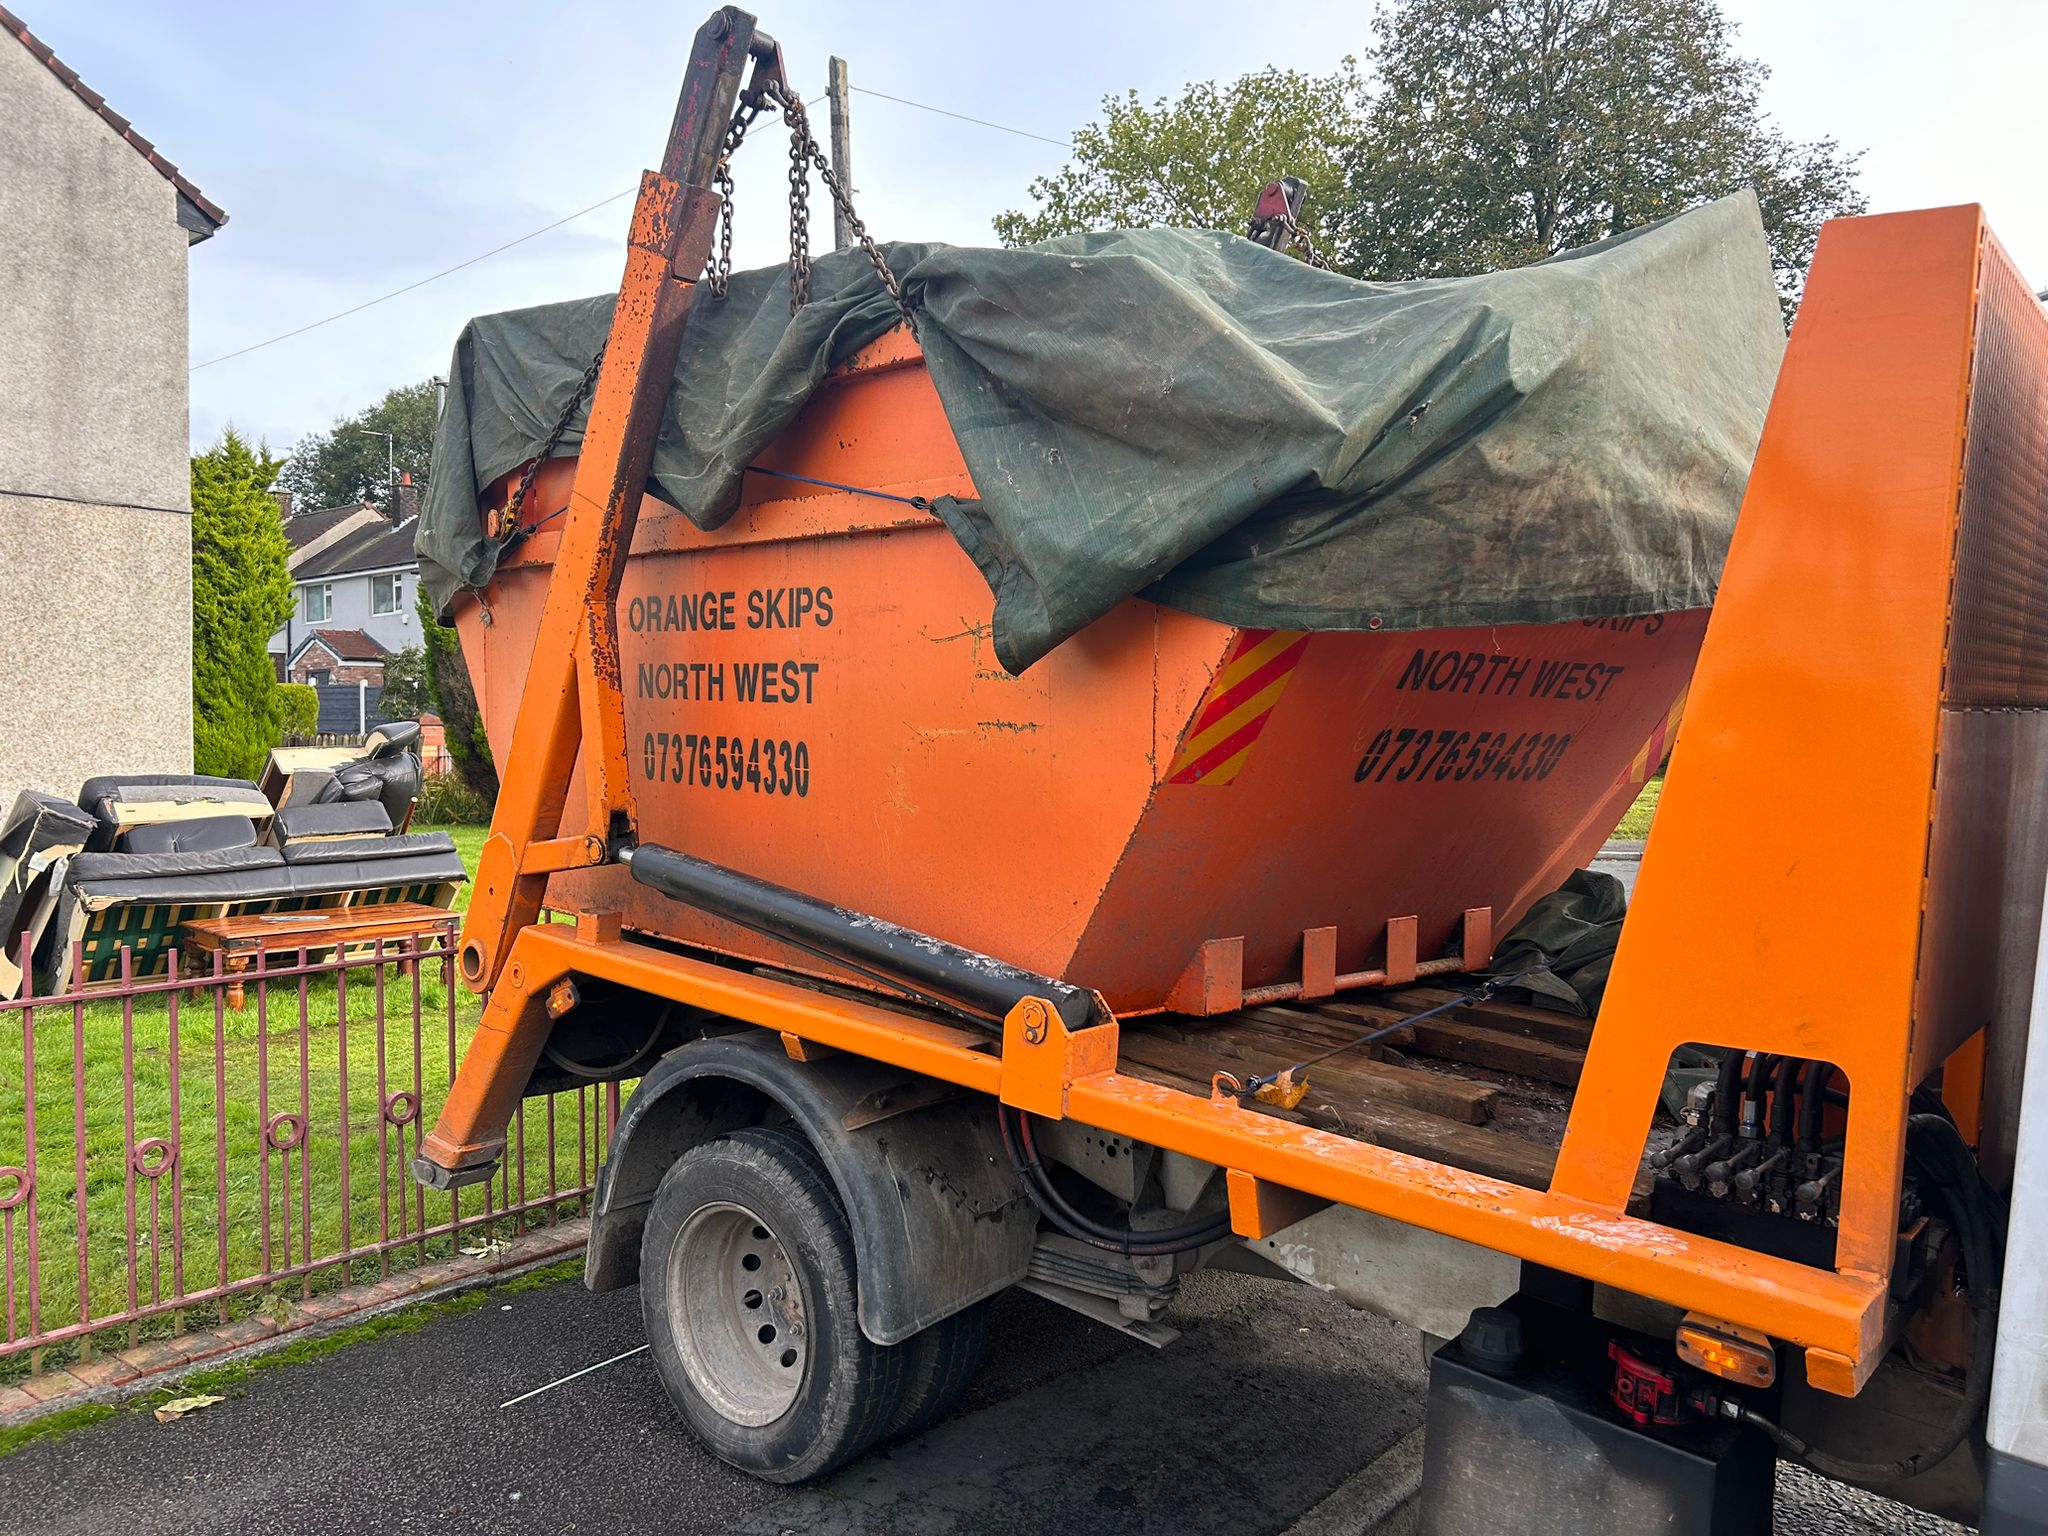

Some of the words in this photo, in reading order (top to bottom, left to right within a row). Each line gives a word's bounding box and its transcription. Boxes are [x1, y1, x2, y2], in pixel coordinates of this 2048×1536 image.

[629, 591, 735, 632] ORANGE
[747, 586, 833, 629] SKIPS
[638, 663, 724, 701] NORTH
[734, 660, 819, 704] WEST
[1396, 648, 1532, 696] NORTH
[1530, 660, 1625, 701] WEST
[644, 732, 809, 798] 07376594330
[1354, 729, 1572, 783] 07376594330
